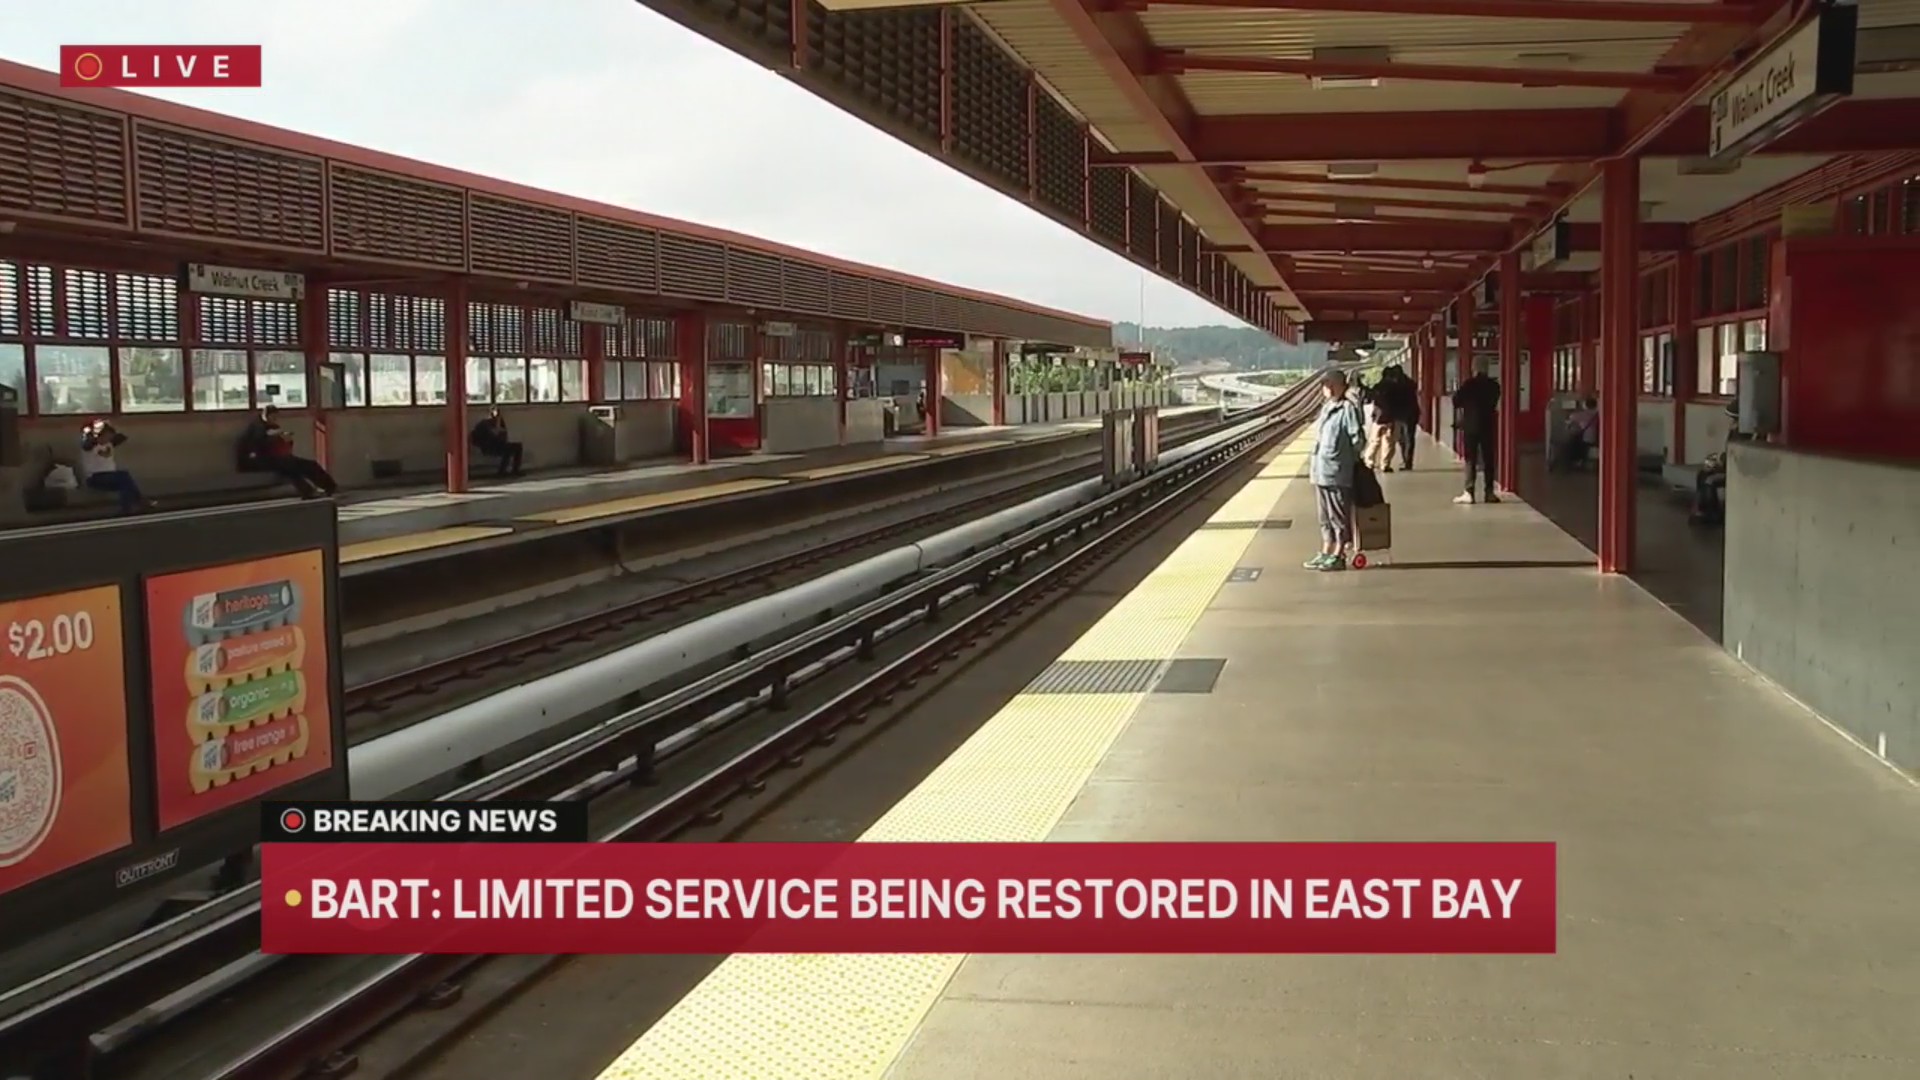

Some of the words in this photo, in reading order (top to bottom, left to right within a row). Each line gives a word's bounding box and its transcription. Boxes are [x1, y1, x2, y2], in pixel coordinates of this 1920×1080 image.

[1731, 82, 1765, 128] Walnut
[1765, 51, 1795, 104] Creek
[211, 271, 249, 290] Walnut
[251, 274, 279, 292] Creek
[225, 594, 270, 614] heritage
[8, 611, 94, 660] $2.00
[229, 687, 271, 709] organic
[233, 739, 255, 754] free
[256, 729, 286, 747] range
[119, 850, 176, 884] OUTFRONT
